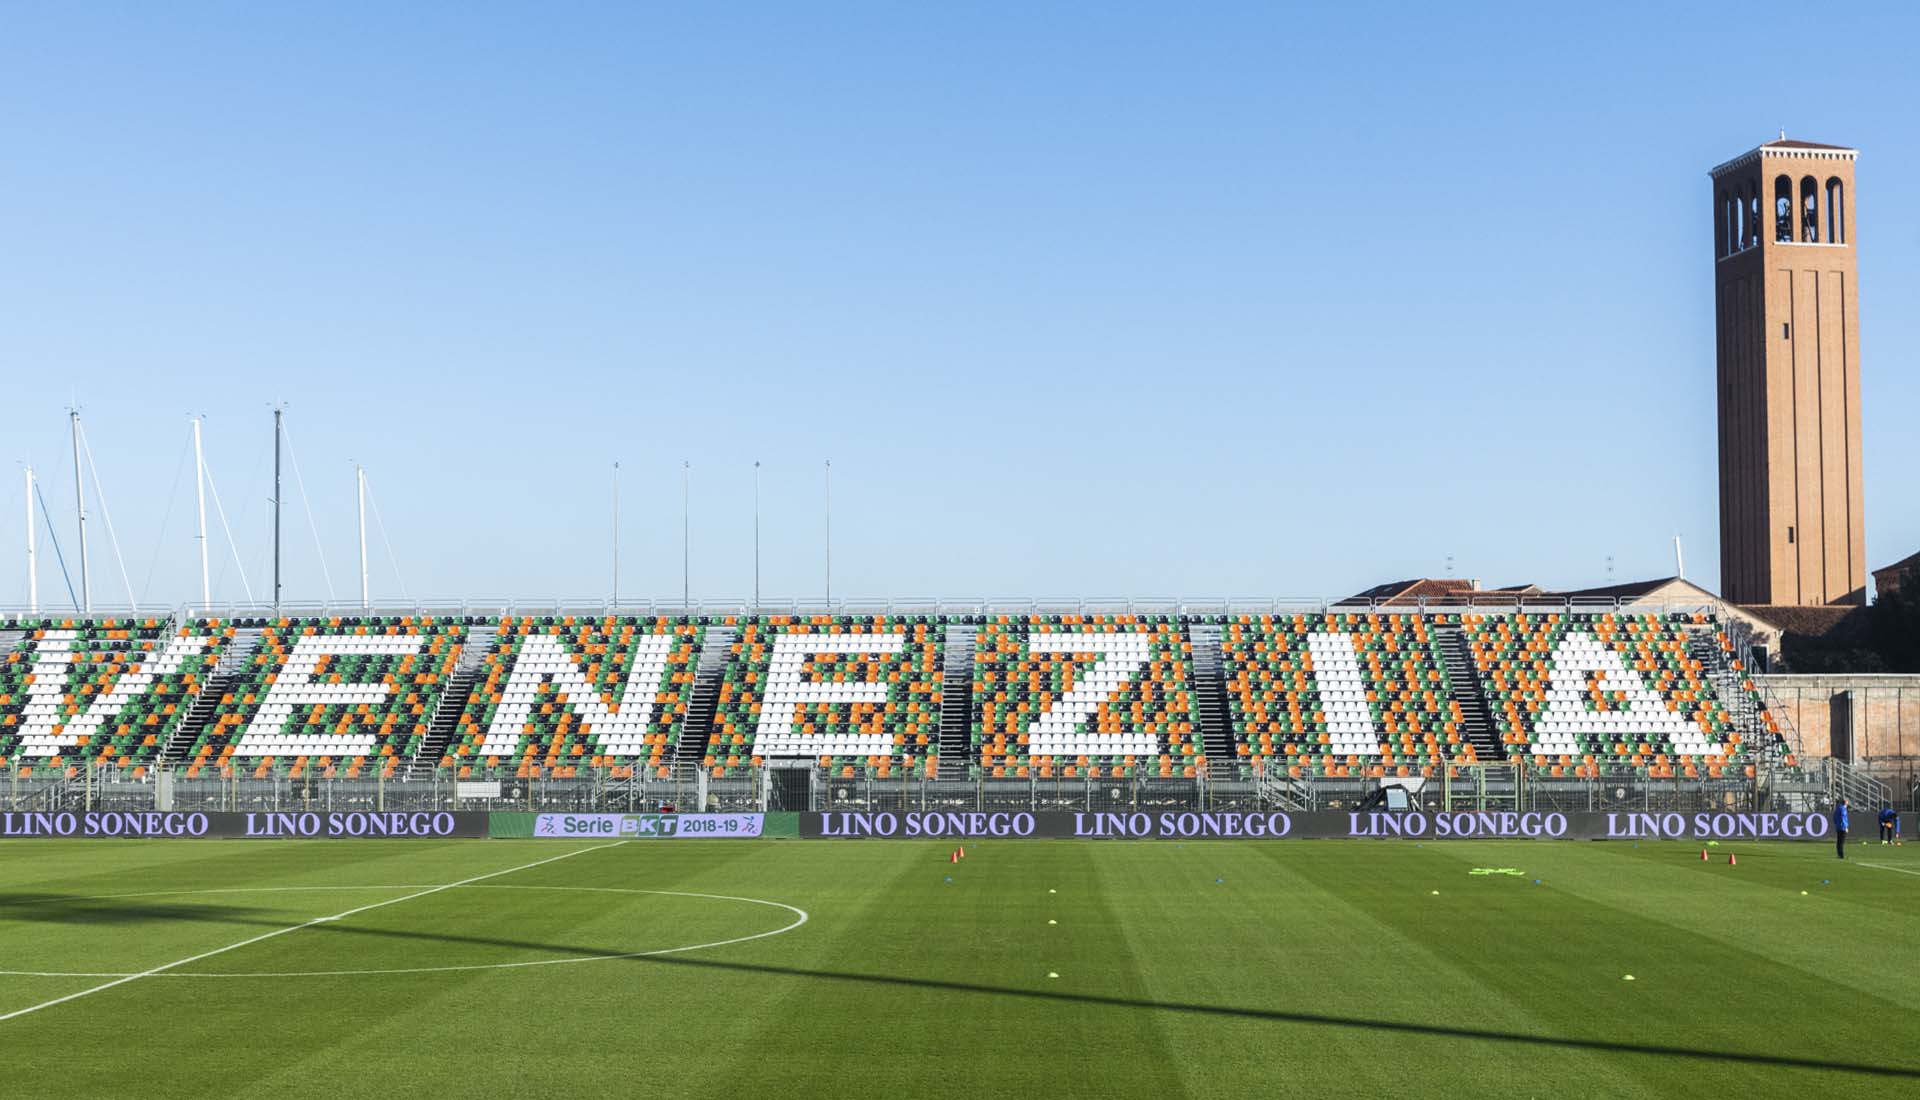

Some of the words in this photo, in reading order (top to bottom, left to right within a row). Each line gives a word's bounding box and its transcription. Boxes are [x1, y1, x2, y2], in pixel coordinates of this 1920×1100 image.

[18, 629, 1726, 757] VENEZIA
[4, 812, 77, 836] LINO
[84, 812, 209, 836] SONEGO
[246, 812, 320, 836] LINO
[329, 812, 455, 836] SONEGO
[563, 815, 614, 833] Serie
[620, 816, 679, 834] BKT
[683, 818, 738, 833] 2018-19
[821, 812, 898, 836] LINO
[905, 812, 1035, 836] SONEGO
[1074, 812, 1152, 836] LINO
[1160, 812, 1291, 836] SONEGO
[1349, 812, 1427, 836] LINO
[1435, 812, 1568, 836] SONEGO
[1607, 812, 1686, 836] LINO
[1694, 812, 1829, 836] SONEGO
